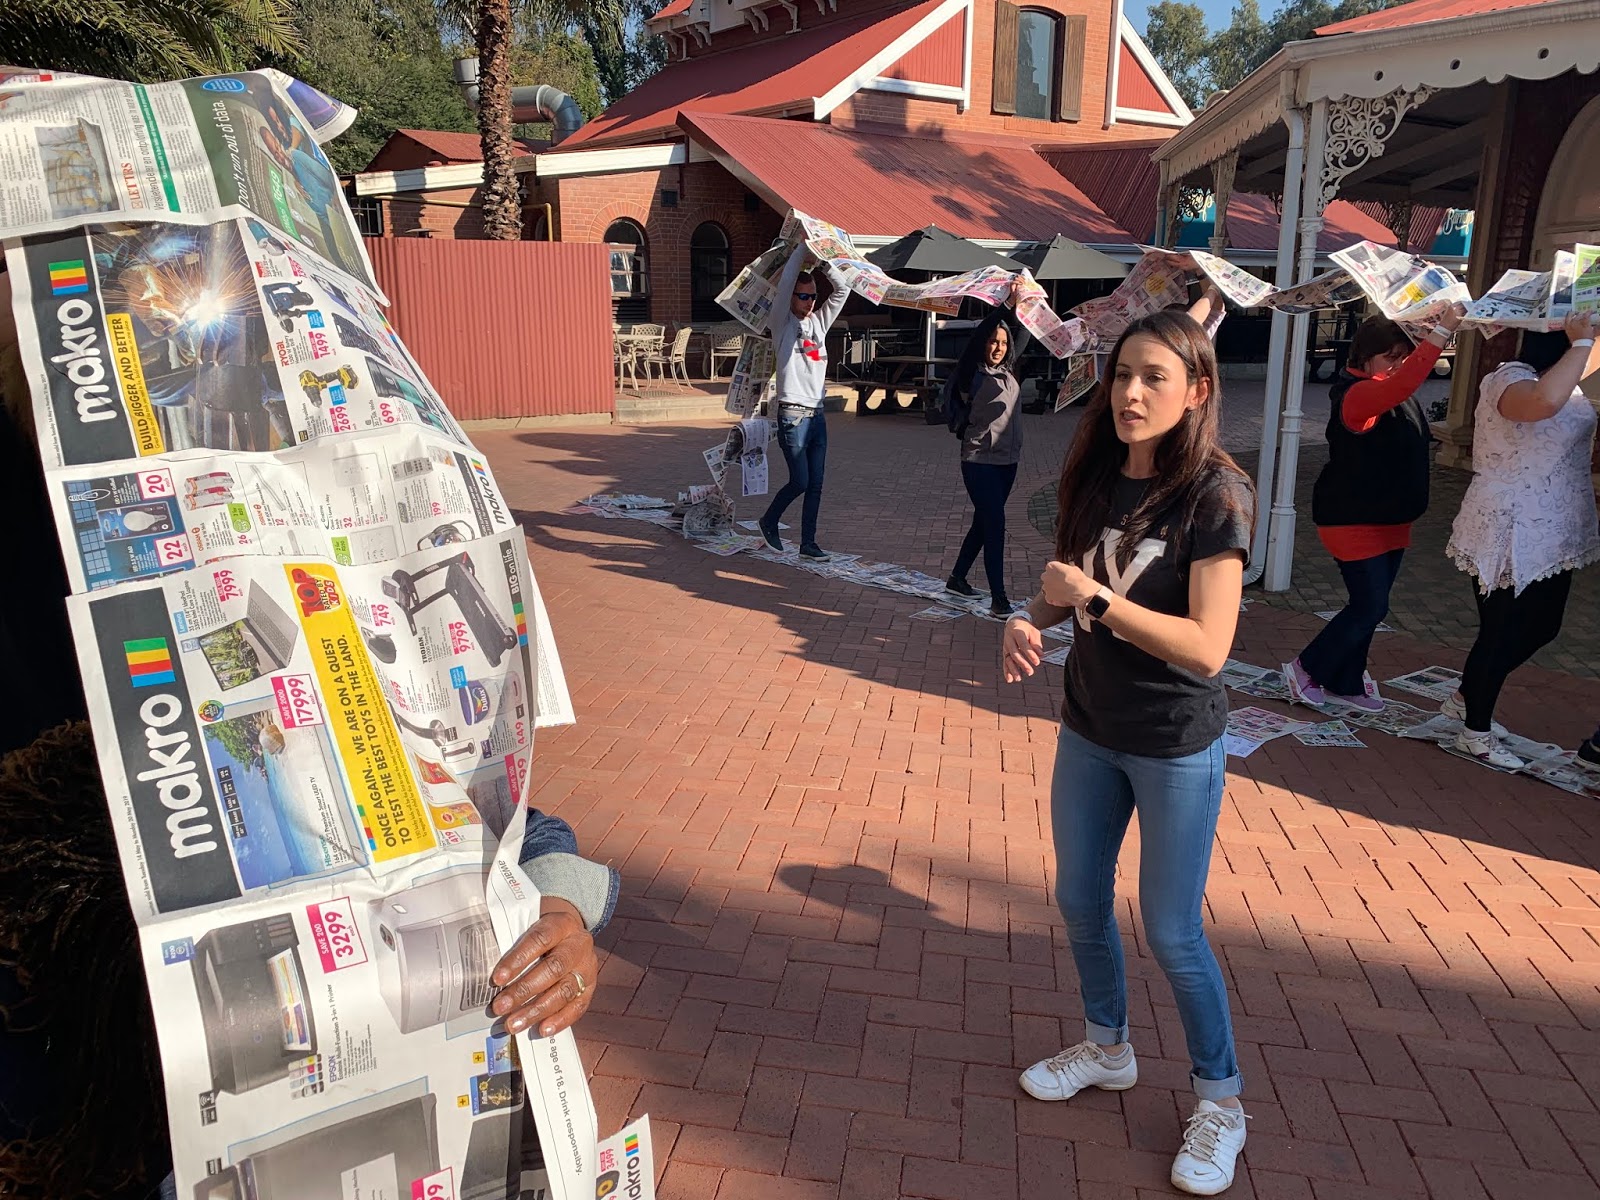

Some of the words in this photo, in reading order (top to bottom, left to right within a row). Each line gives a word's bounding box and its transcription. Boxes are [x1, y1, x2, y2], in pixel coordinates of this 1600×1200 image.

[212, 100, 230, 122] data.
[215, 123, 233, 133] of
[224, 135, 239, 153] out
[230, 154, 243, 174] run
[232, 175, 251, 208] Don't
[111, 318, 128, 353] BETTER
[315, 332, 331, 358] 1499
[51, 299, 117, 423] makro
[276, 340, 290, 367] RYOBI
[119, 357, 135, 380] AND
[127, 384, 145, 417] BIGGER
[335, 406, 351, 431] 2699
[379, 403, 395, 423] 699
[136, 419, 154, 450] BUILD
[151, 437, 161, 449] Great
[146, 475, 166, 494] 20
[432, 502, 442, 516] 199
[478, 476, 507, 524] makro
[275, 518, 285, 526] 12
[343, 517, 353, 528] 32
[237, 534, 248, 545] 26
[164, 541, 183, 560] 22
[503, 549, 514, 561] life
[508, 564, 516, 574] on
[219, 570, 239, 600] 7999
[291, 568, 325, 617] TOP
[315, 578, 324, 587] BY
[323, 580, 340, 605] KIDS
[510, 575, 520, 594] BIG
[319, 590, 331, 610] RATED
[378, 604, 391, 626] 749
[455, 621, 471, 652] 9799
[321, 638, 340, 673] QUEST
[337, 634, 354, 667] LAND.
[418, 637, 428, 664] TROJAN
[334, 675, 344, 684] A
[347, 671, 361, 691] THE
[277, 689, 287, 704] 2000
[287, 678, 314, 724] 17999
[308, 694, 316, 705] each
[339, 688, 353, 706] ON
[356, 694, 369, 706] IN
[480, 690, 490, 711] Dulux
[281, 705, 291, 720] SAVE
[344, 709, 360, 731] ARE
[359, 710, 379, 741] TOYS
[515, 721, 526, 744] 449
[352, 735, 366, 755] WE
[370, 743, 388, 770] BEST
[137, 694, 218, 859] makro
[362, 757, 385, 809] AGAIN...
[380, 773, 397, 796] THE
[510, 778, 518, 792] SAVE
[122, 796, 131, 806] 2019
[315, 796, 325, 811] Smart
[320, 811, 330, 832] Premium
[388, 799, 405, 825] TEST
[376, 813, 397, 847] ONCE
[398, 827, 413, 844] TO
[444, 831, 460, 843] 419
[319, 835, 333, 867] Hisense
[314, 923, 324, 936] 200
[325, 911, 353, 957] 3299
[347, 925, 355, 936] each
[318, 938, 329, 954] SAVE
[327, 984, 336, 1002] Printer
[330, 1005, 338, 1021] 3-in-1
[549, 1047, 560, 1063] age
[328, 1055, 337, 1083] EPSON
[552, 1065, 563, 1074] of
[554, 1076, 565, 1090] 18.
[557, 1091, 571, 1117] Drink
[564, 1119, 583, 1176] responsibly.
[605, 1149, 615, 1170] 3499
[624, 1157, 642, 1200] akro
